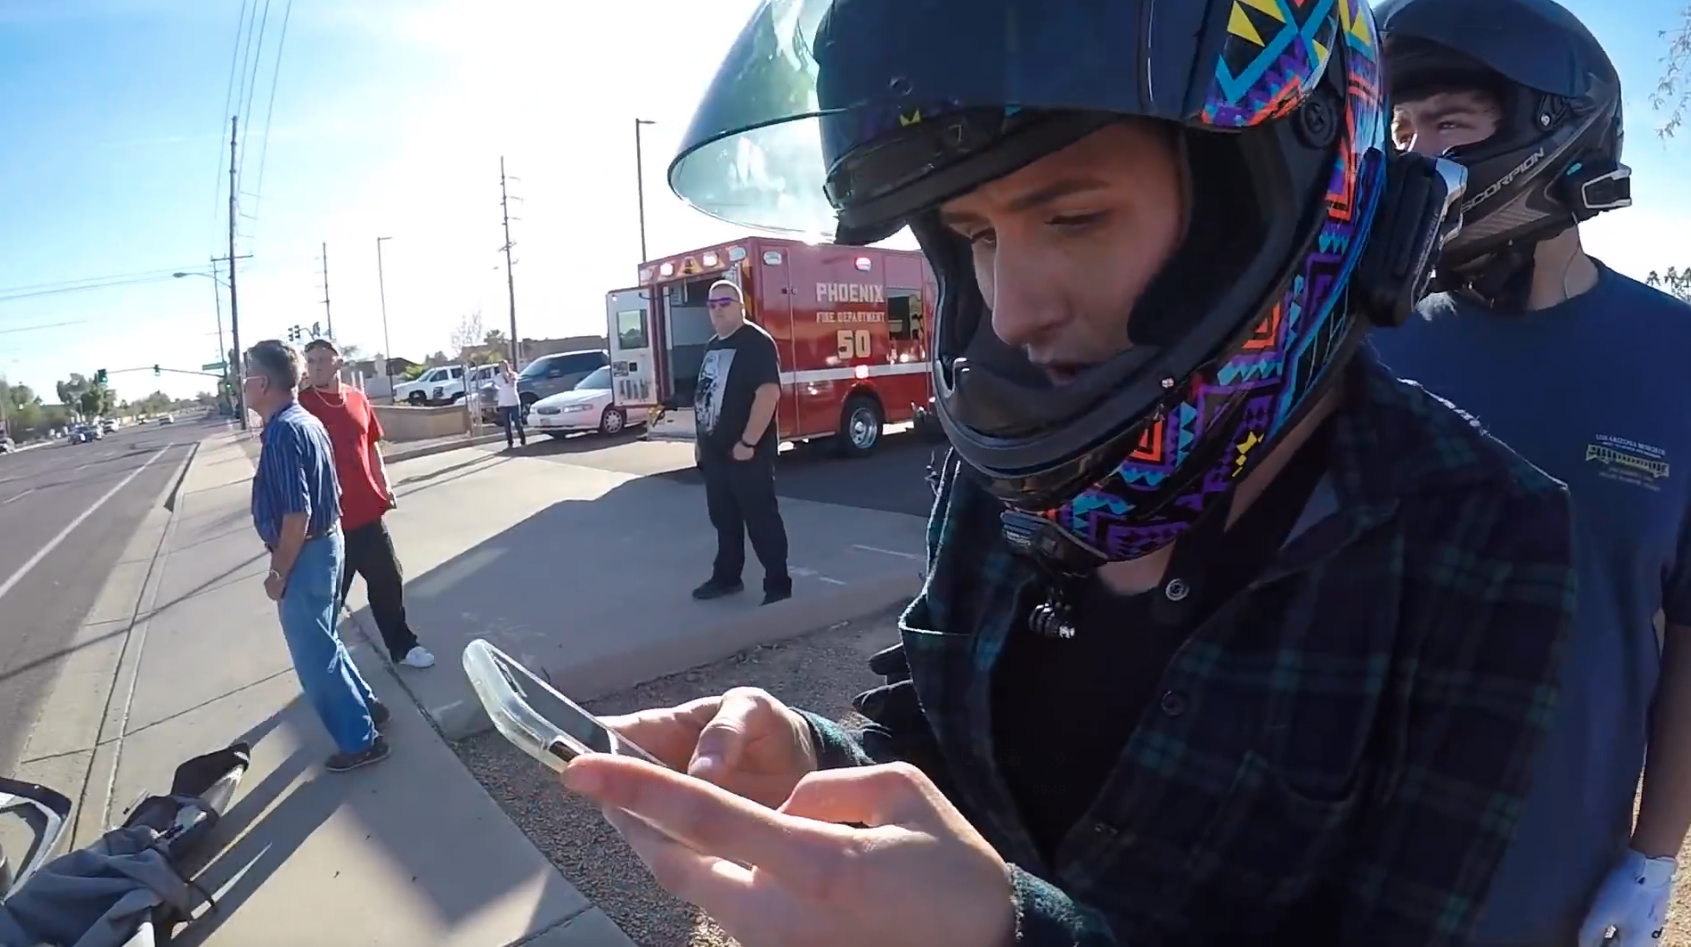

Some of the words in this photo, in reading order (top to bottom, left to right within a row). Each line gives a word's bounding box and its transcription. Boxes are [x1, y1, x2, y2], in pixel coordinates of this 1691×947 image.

[1460, 148, 1545, 214] SCORPION
[816, 283, 884, 303] PHOENIX
[816, 311, 835, 323] FIRE
[837, 311, 885, 323] DEPARTMENT
[837, 330, 871, 359] 50
